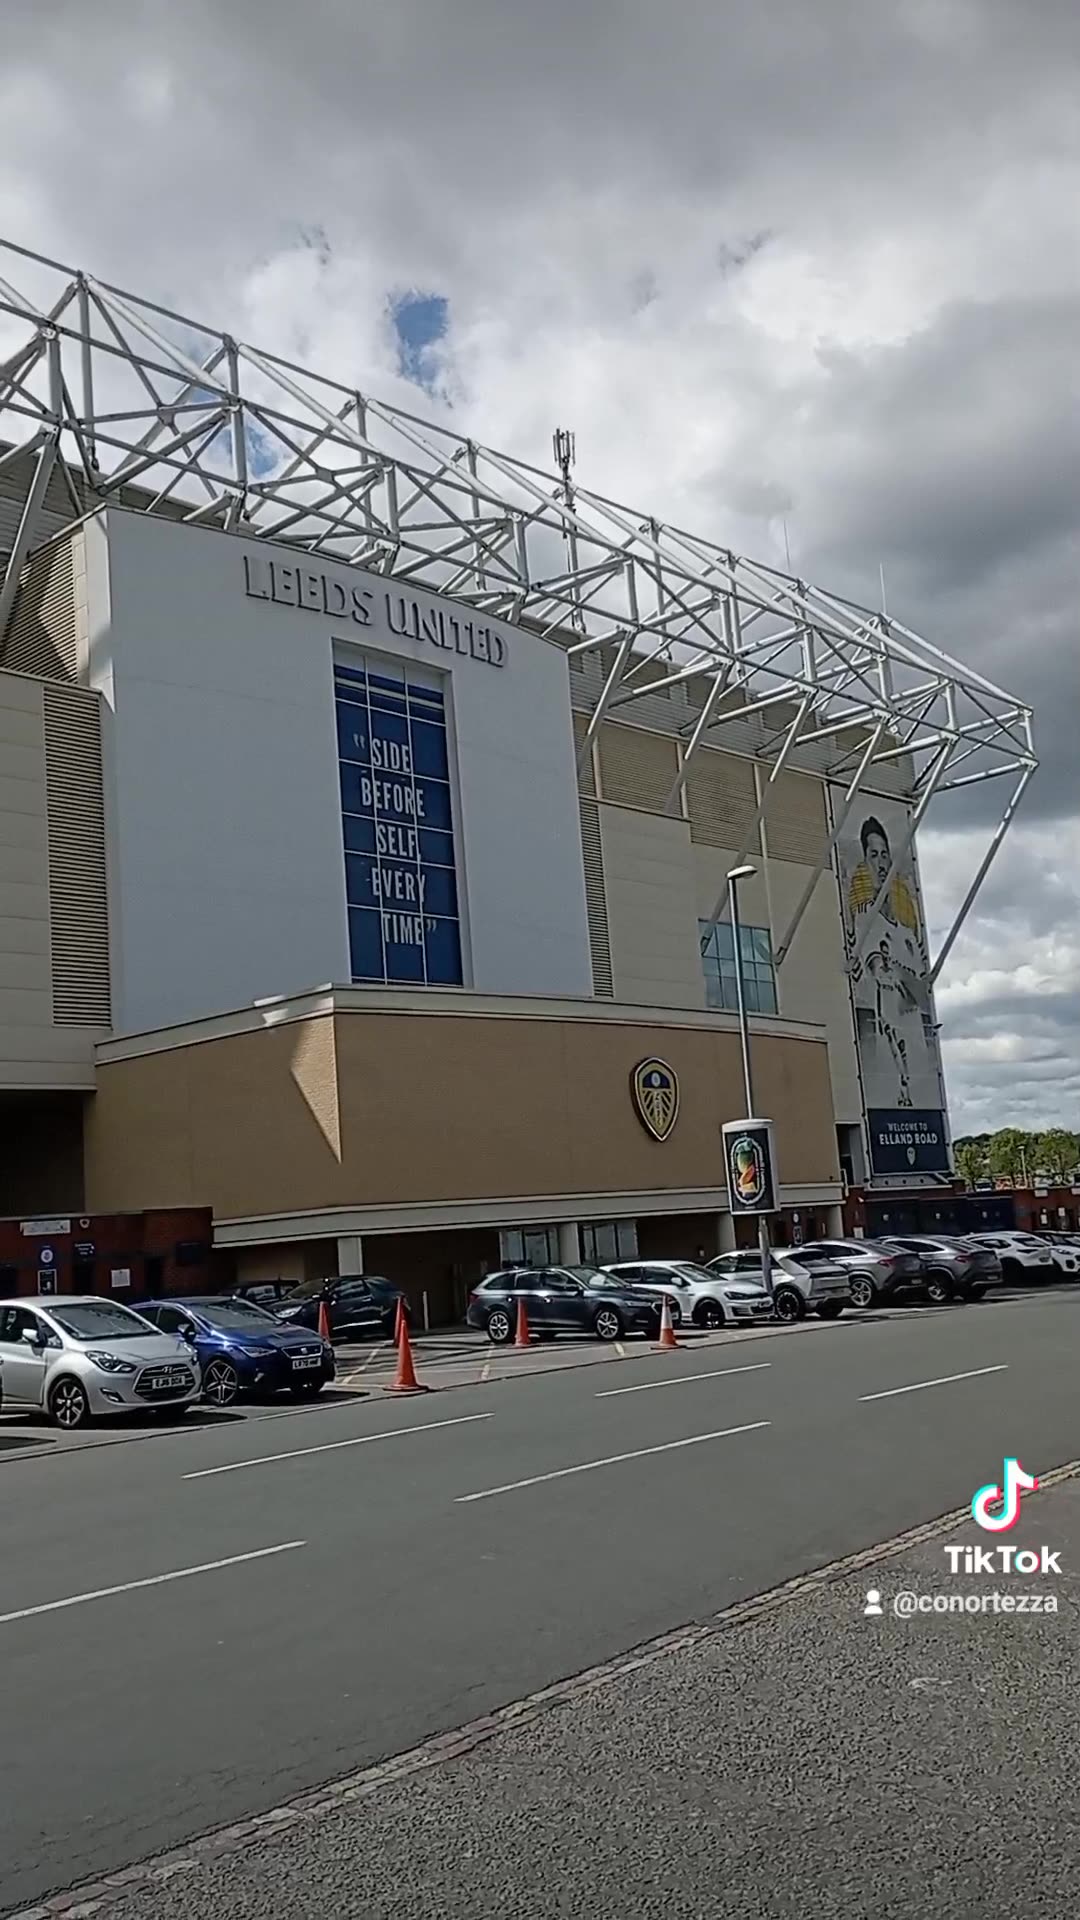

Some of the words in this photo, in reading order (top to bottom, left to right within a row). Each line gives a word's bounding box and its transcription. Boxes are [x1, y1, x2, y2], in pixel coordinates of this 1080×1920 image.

[243, 555, 373, 627] LEEDS
[385, 593, 509, 668] UNITED
[361, 777, 426, 817] BEFORE
[371, 867, 426, 903] EVERY
[879, 1133, 913, 1145] ELLAND
[914, 1133, 938, 1144] ROAD
[887, 1122, 918, 1131] WELCOME
[919, 1122, 928, 1131] TO
